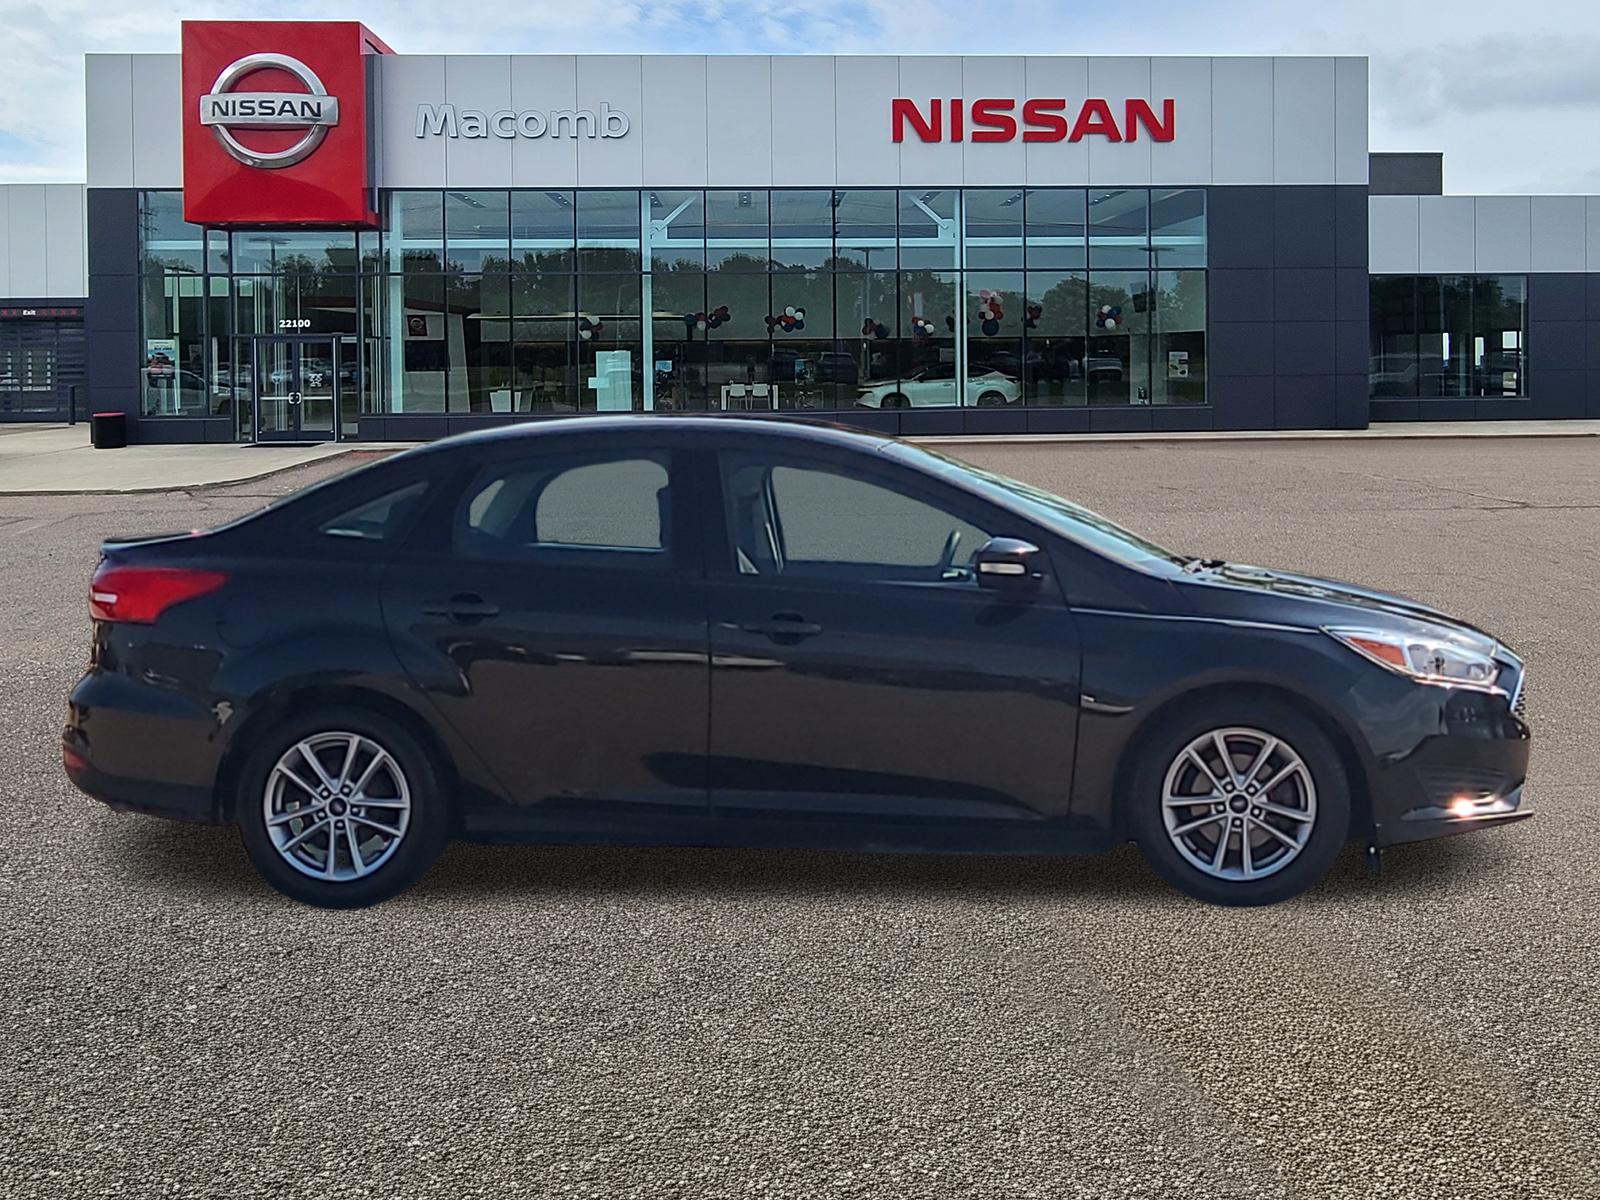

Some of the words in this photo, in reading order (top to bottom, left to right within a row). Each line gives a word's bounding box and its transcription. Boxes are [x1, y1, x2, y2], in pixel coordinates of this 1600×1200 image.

[211, 100, 322, 118] NISSAN
[415, 102, 630, 139] Macomb
[892, 98, 1175, 143] NISSAN
[279, 319, 311, 328] 22100
